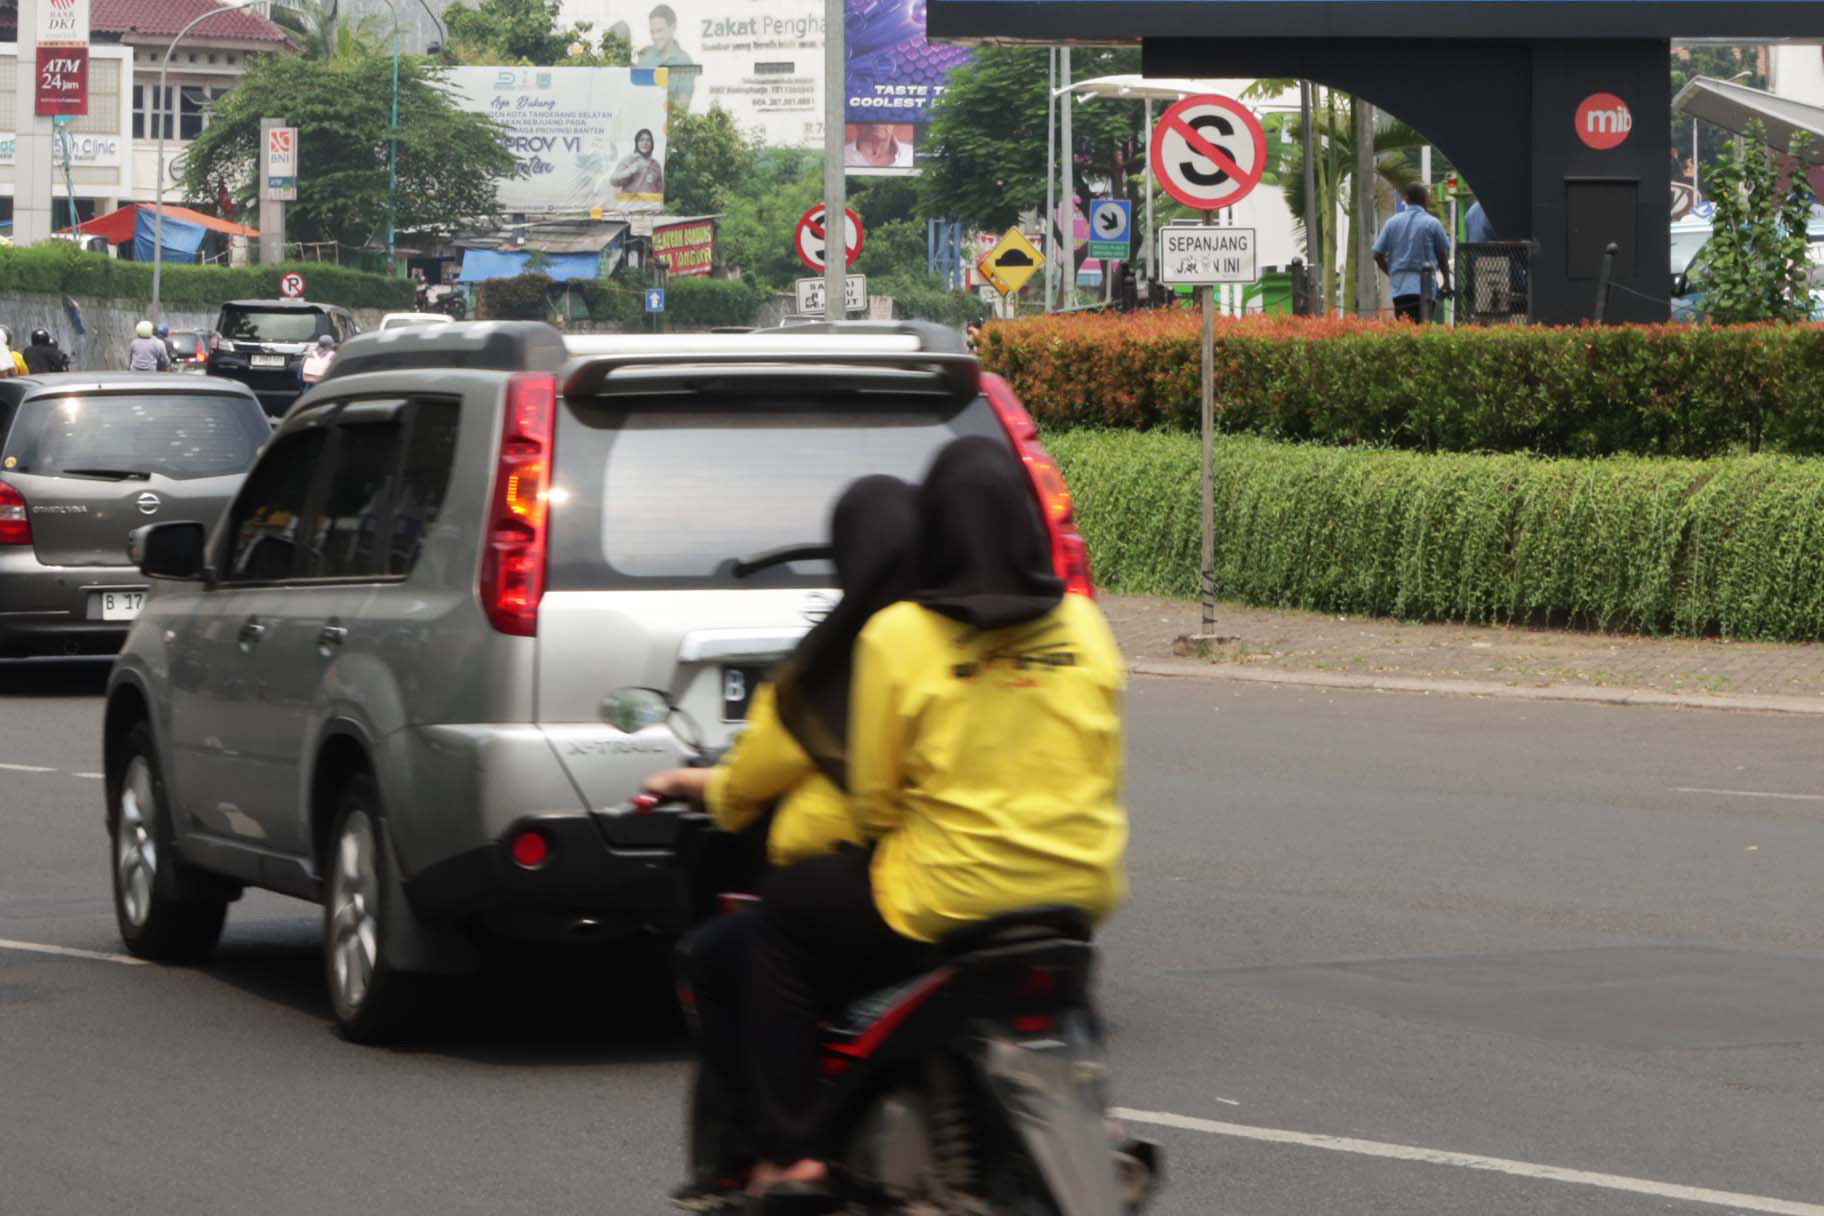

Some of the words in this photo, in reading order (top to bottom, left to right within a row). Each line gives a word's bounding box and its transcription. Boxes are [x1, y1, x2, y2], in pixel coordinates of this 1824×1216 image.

[49, 18, 76, 30] DKI
[701, 17, 757, 38] Zakat
[763, 12, 826, 39] Pengha
[42, 58, 81, 73] ATM
[41, 73, 62, 90] 24
[874, 84, 928, 96] TASTE
[849, 96, 926, 109] COOLEST
[54, 139, 80, 154] Sin
[82, 138, 117, 155] Clinic
[1168, 236, 1248, 252] SEPANJANG
[1223, 257, 1240, 273] INI
[106, 594, 115, 610] B
[725, 669, 745, 701] B
